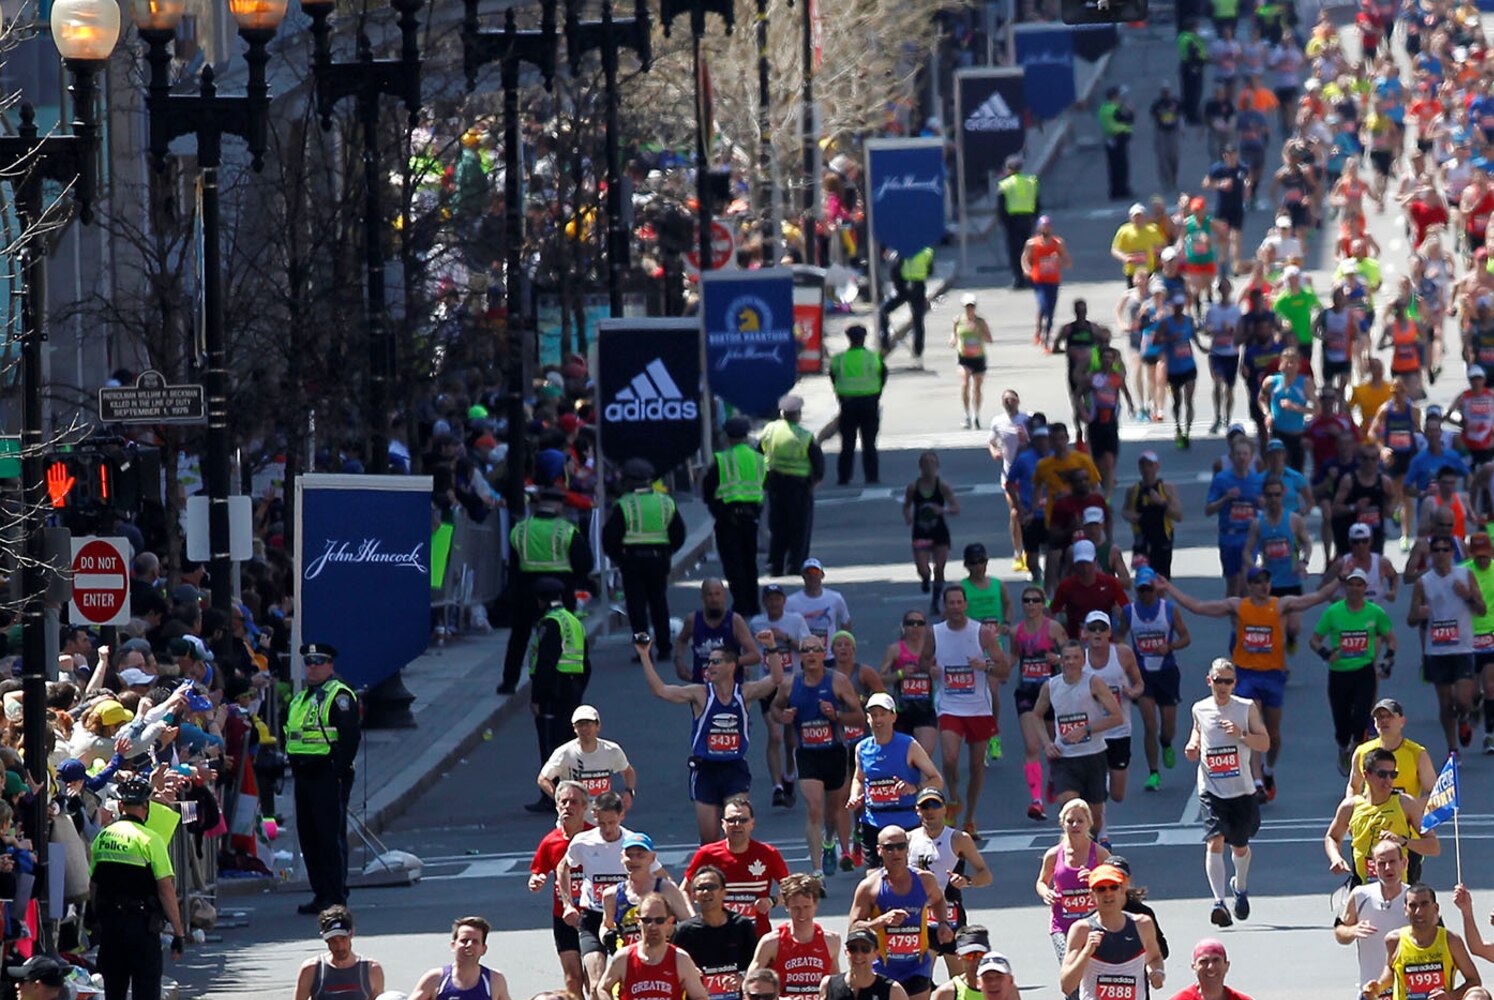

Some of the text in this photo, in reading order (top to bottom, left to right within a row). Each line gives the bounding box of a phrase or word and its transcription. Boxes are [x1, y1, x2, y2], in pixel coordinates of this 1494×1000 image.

[113, 407, 160, 416] SEPTEMBER
[605, 398, 697, 423] adidas
[80, 557, 117, 570] DO NOT
[82, 593, 115, 608] ENTER
[1342, 637, 1367, 646] 4377
[710, 735, 736, 746] 5431
[1209, 756, 1236, 767] 3048
[98, 841, 128, 852] Police
[1064, 895, 1094, 907] 6492
[888, 935, 919, 946] 4799
[784, 957, 824, 971] GREATER
[786, 973, 823, 982] BOSTON
[1408, 974, 1441, 985] 1993
[631, 980, 673, 994] GREATER
[1100, 985, 1132, 998] 7888
